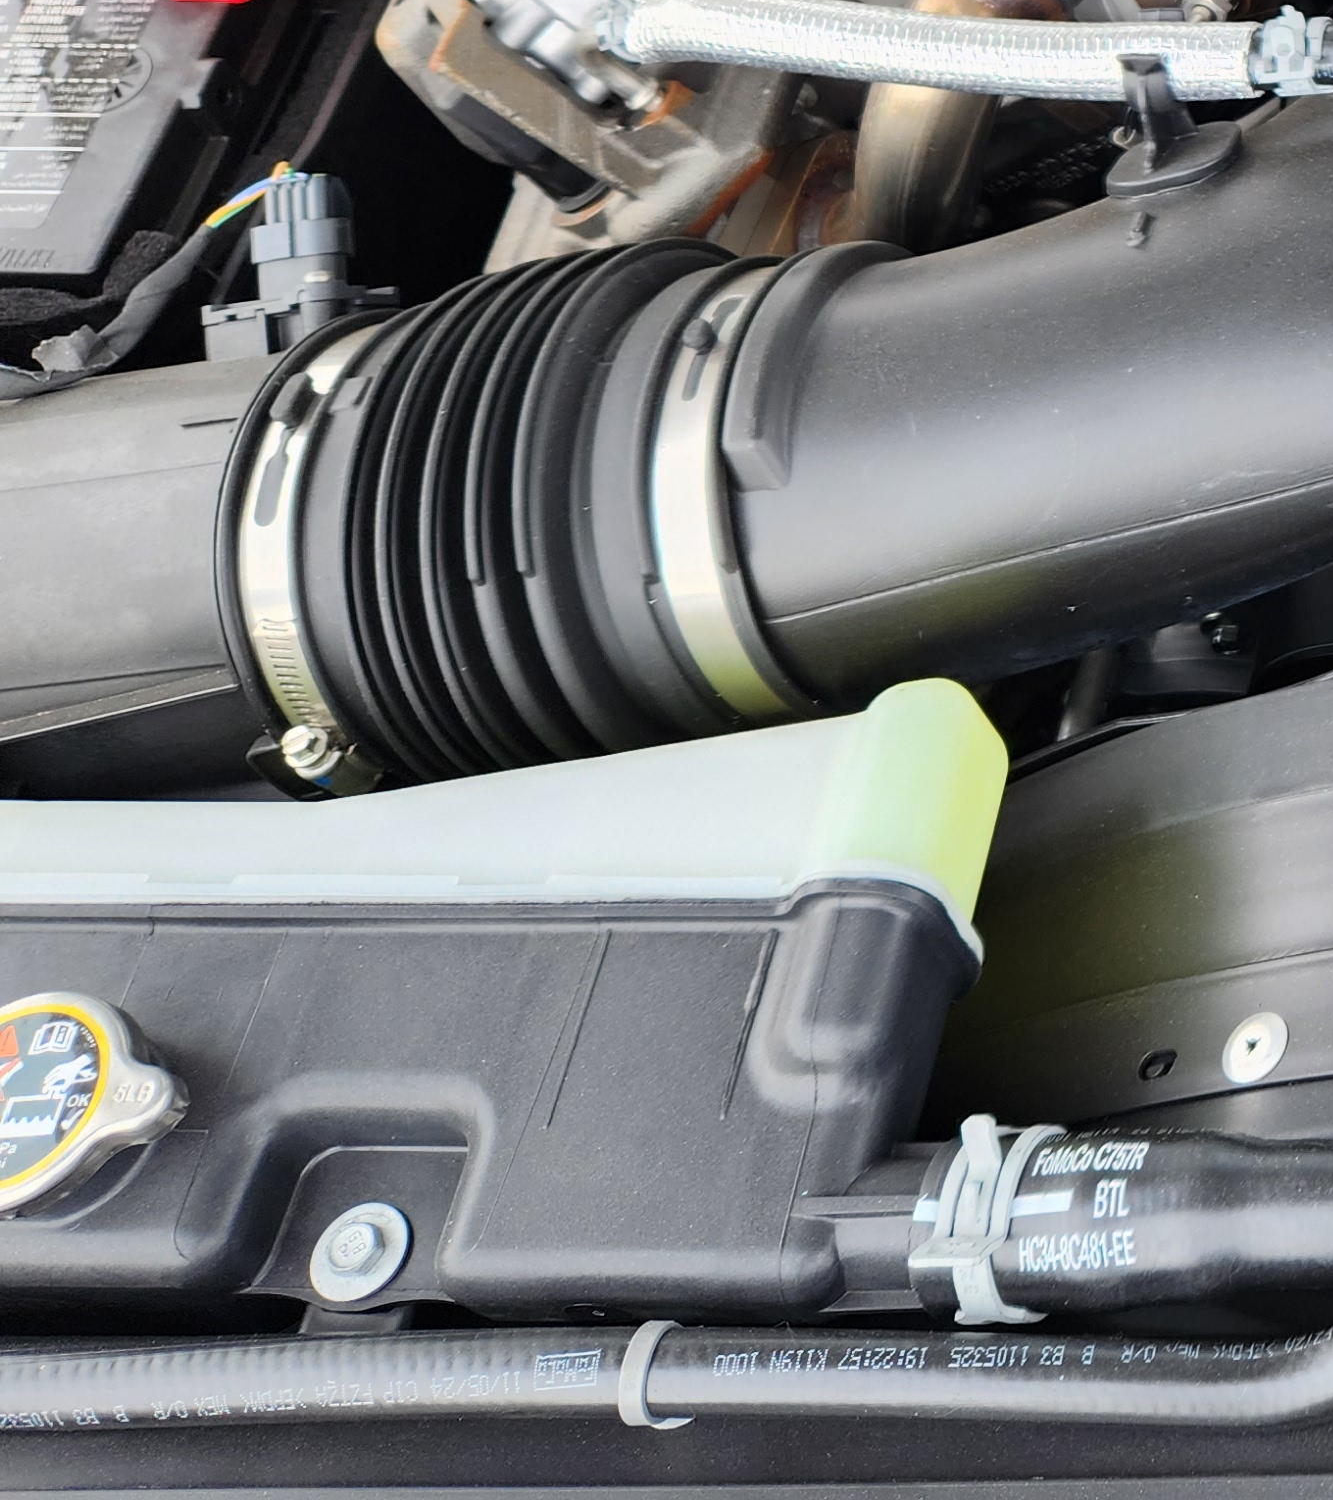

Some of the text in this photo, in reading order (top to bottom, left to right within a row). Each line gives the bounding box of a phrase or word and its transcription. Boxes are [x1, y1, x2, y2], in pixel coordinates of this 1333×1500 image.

[66, 1093, 93, 1108] OK
[113, 1082, 154, 1101] 5LB
[1031, 1141, 1149, 1177] FoMoCo C757R
[1092, 1178, 1131, 1219] BTL
[712, 1352, 760, 1377] 1000
[769, 1348, 829, 1370] K119N
[836, 1345, 930, 1370] 19:22:57
[947, 1344, 1031, 1369] 1105325
[1038, 1344, 1066, 1366] B3
[1081, 1344, 1095, 1365] B
[383, 1379, 419, 1402] CIP
[430, 1369, 521, 1397] 11/05/24
[71, 1405, 99, 1426] B3
[111, 1403, 129, 1423] B
[193, 1394, 229, 1416] MEX
